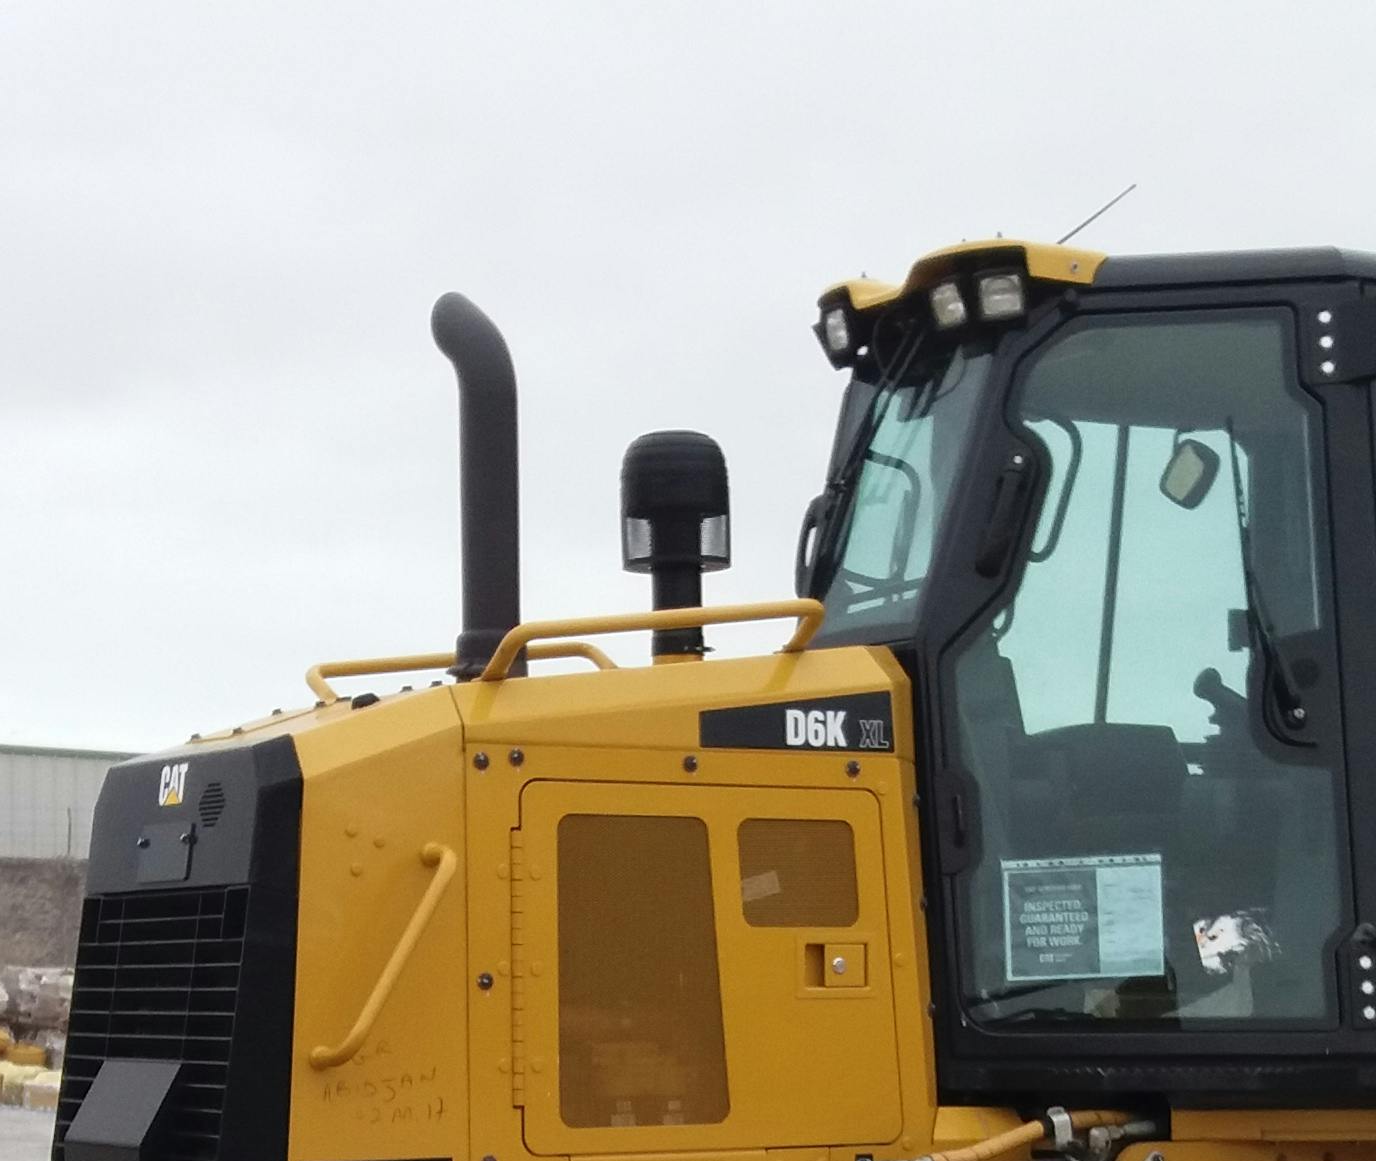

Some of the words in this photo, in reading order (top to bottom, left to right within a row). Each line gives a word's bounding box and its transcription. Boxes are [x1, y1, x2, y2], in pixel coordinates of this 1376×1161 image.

[785, 708, 848, 747] D6K
[859, 719, 890, 749] XL
[159, 762, 189, 807] CAT
[1025, 924, 1048, 936] AND
[1050, 923, 1084, 935] READY
[1026, 936, 1048, 948] FOR
